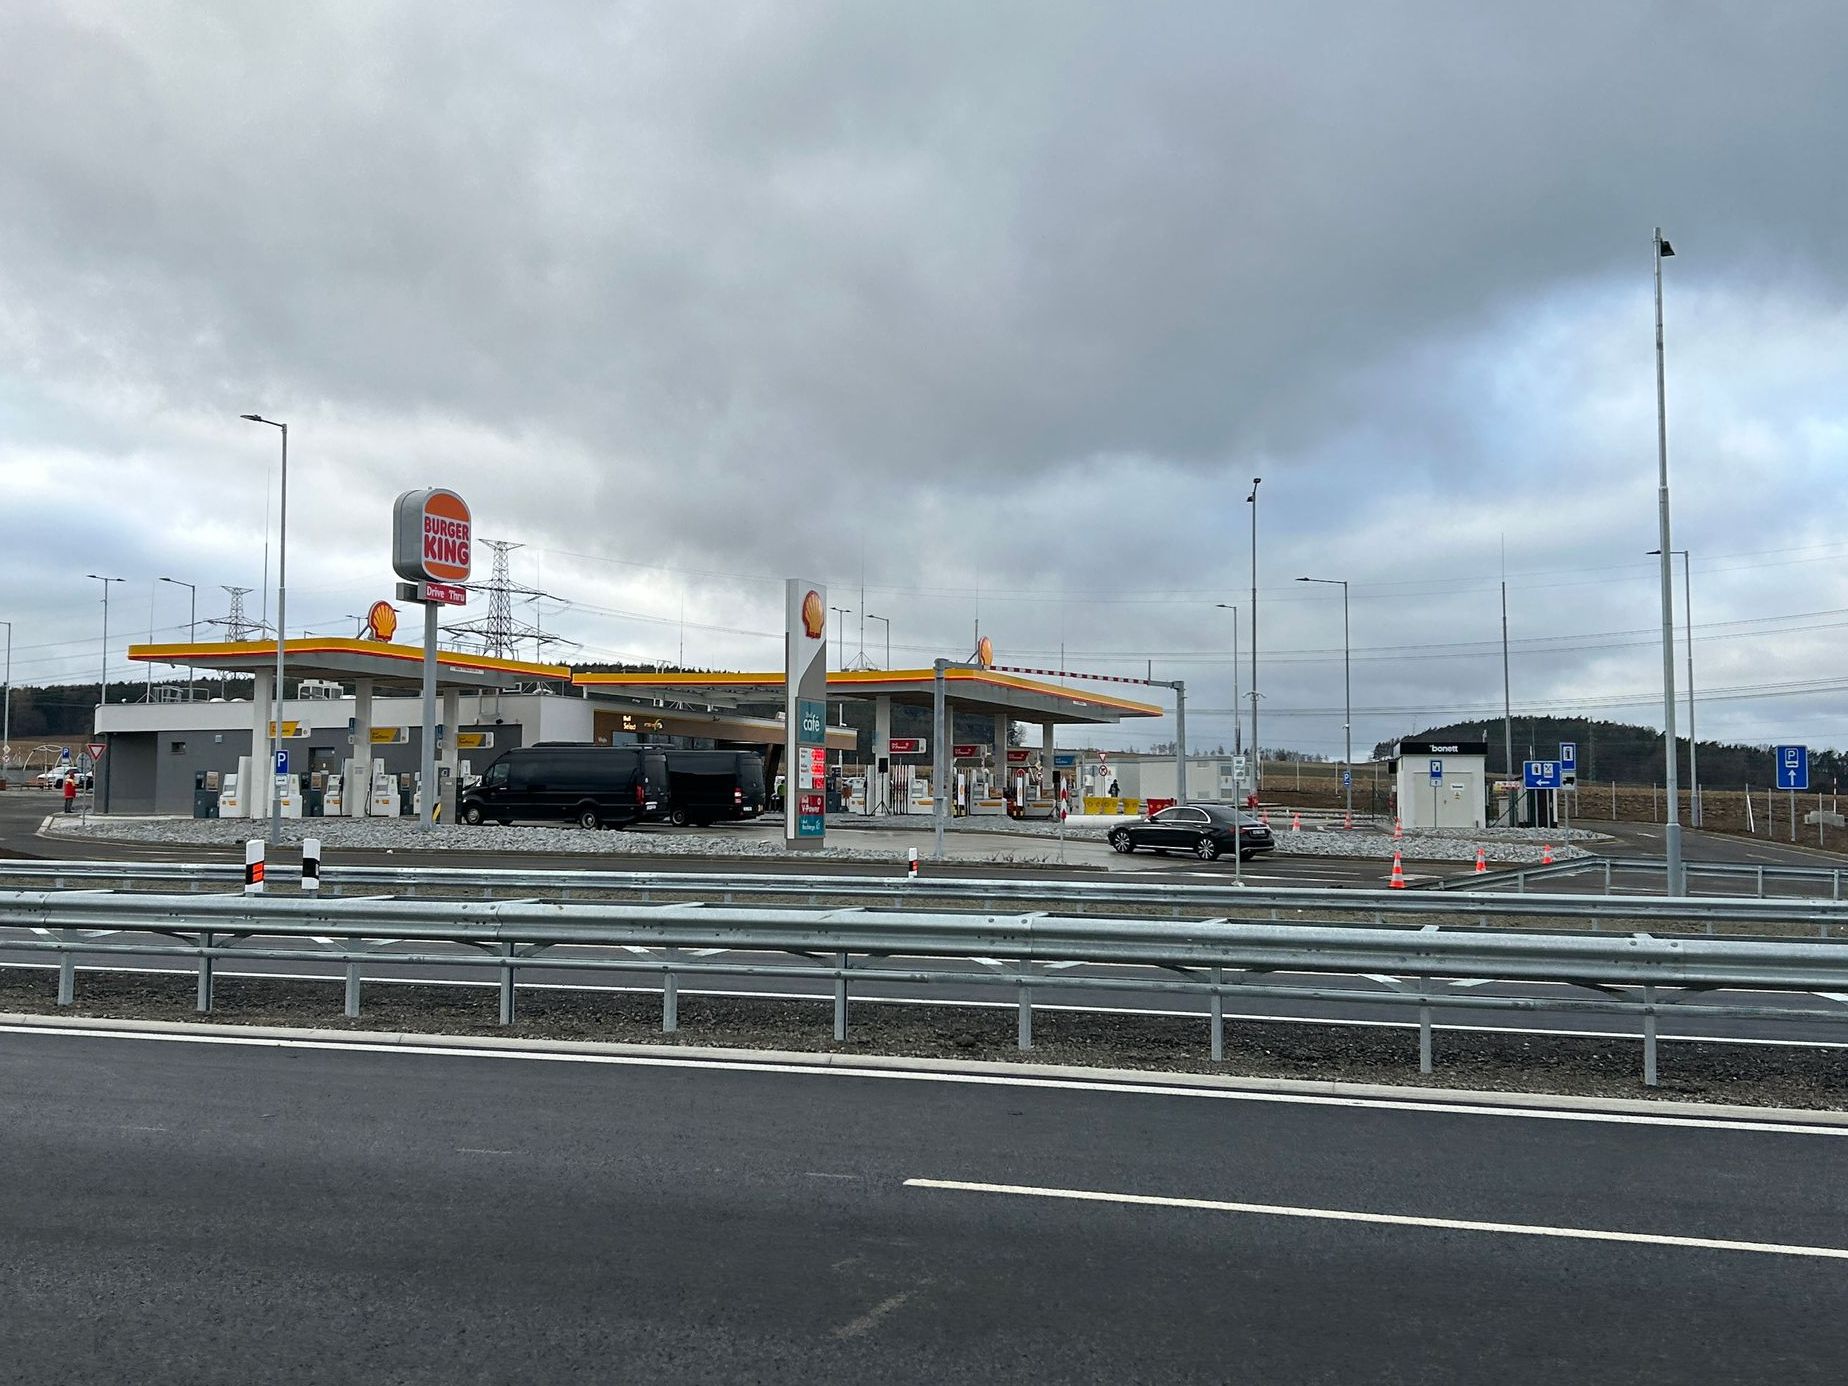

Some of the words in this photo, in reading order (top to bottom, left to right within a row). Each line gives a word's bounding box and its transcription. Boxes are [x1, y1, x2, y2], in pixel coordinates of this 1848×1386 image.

[424, 516, 469, 541] BURGER
[424, 534, 469, 566] KING
[426, 586, 445, 599] Drive
[448, 590, 466, 602] Thru
[803, 714, 820, 732] café
[1431, 745, 1459, 753] bonett
[1787, 750, 1796, 761] P
[277, 752, 287, 767] P
